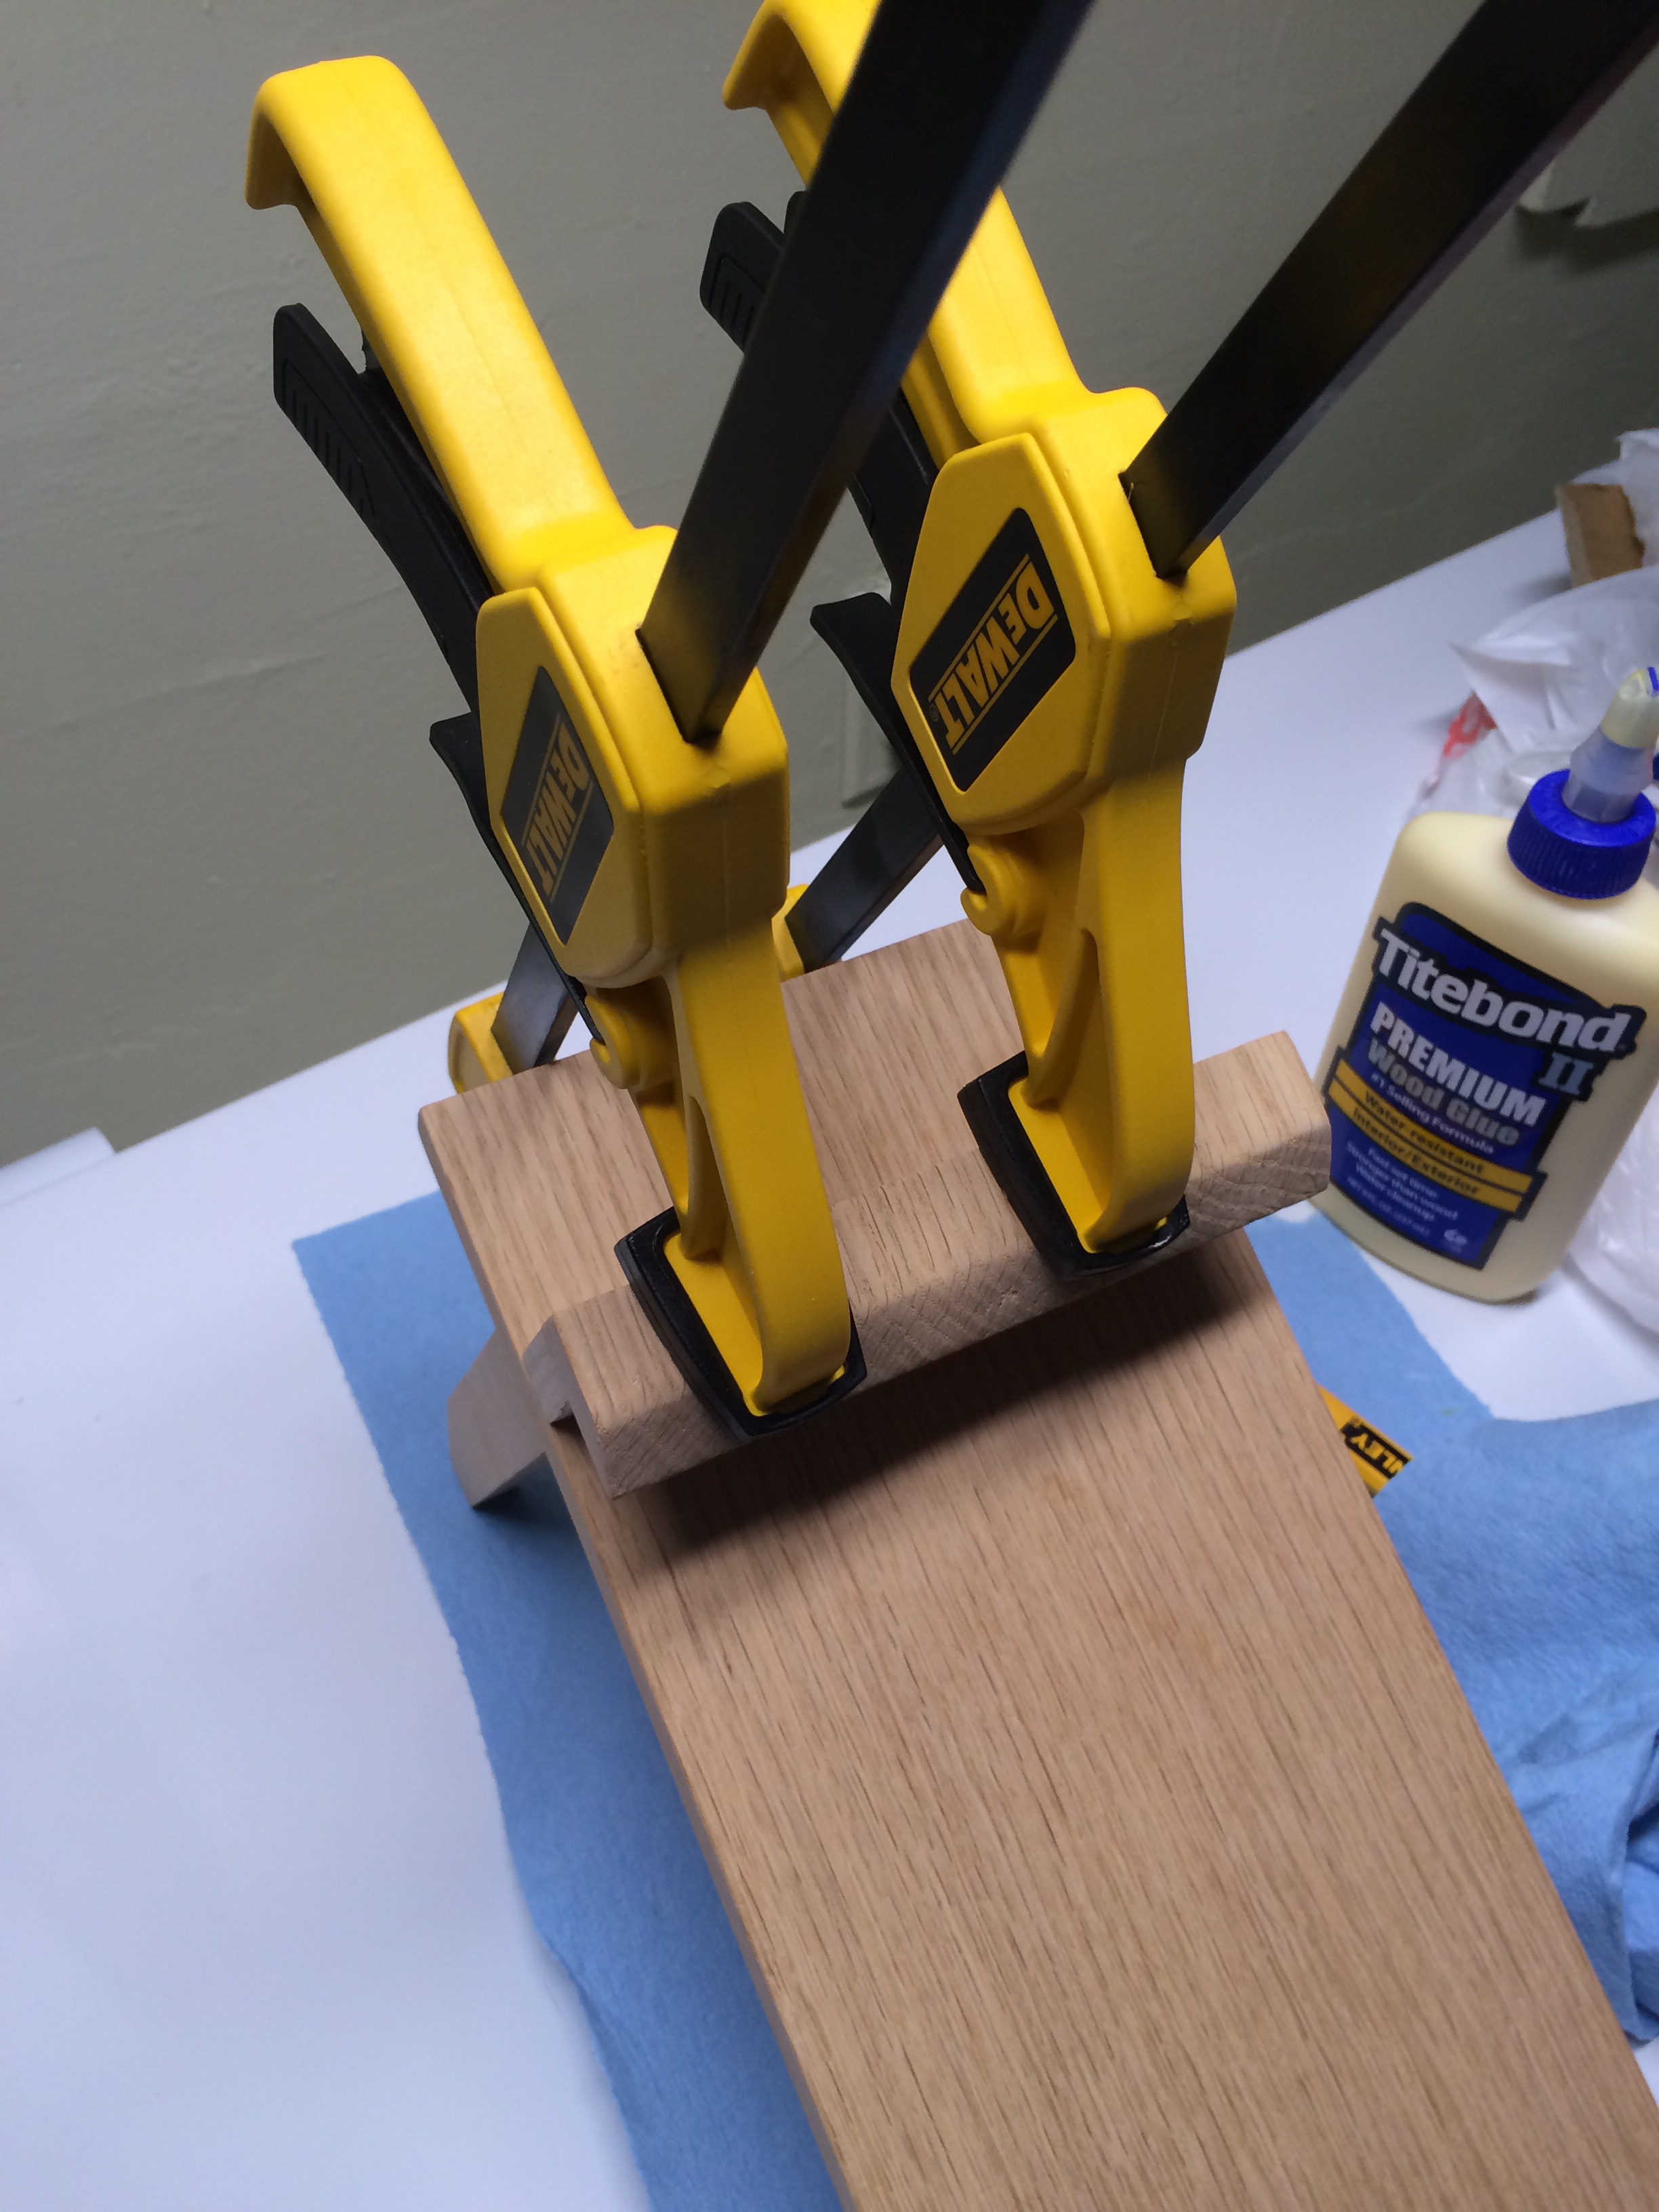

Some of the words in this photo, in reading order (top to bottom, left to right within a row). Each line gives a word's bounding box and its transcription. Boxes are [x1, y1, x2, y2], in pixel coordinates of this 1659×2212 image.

[935, 562, 1054, 747] DEWALT
[526, 722, 590, 897] DEWALT
[1380, 928, 1632, 1053] Titebond
[1365, 1089, 1406, 1130] Water
[1367, 1040, 1445, 1110] Wood
[1446, 1097, 1521, 1147] Glue
[1370, 1001, 1547, 1127] PREMIUM
[1538, 1051, 1595, 1097] II
